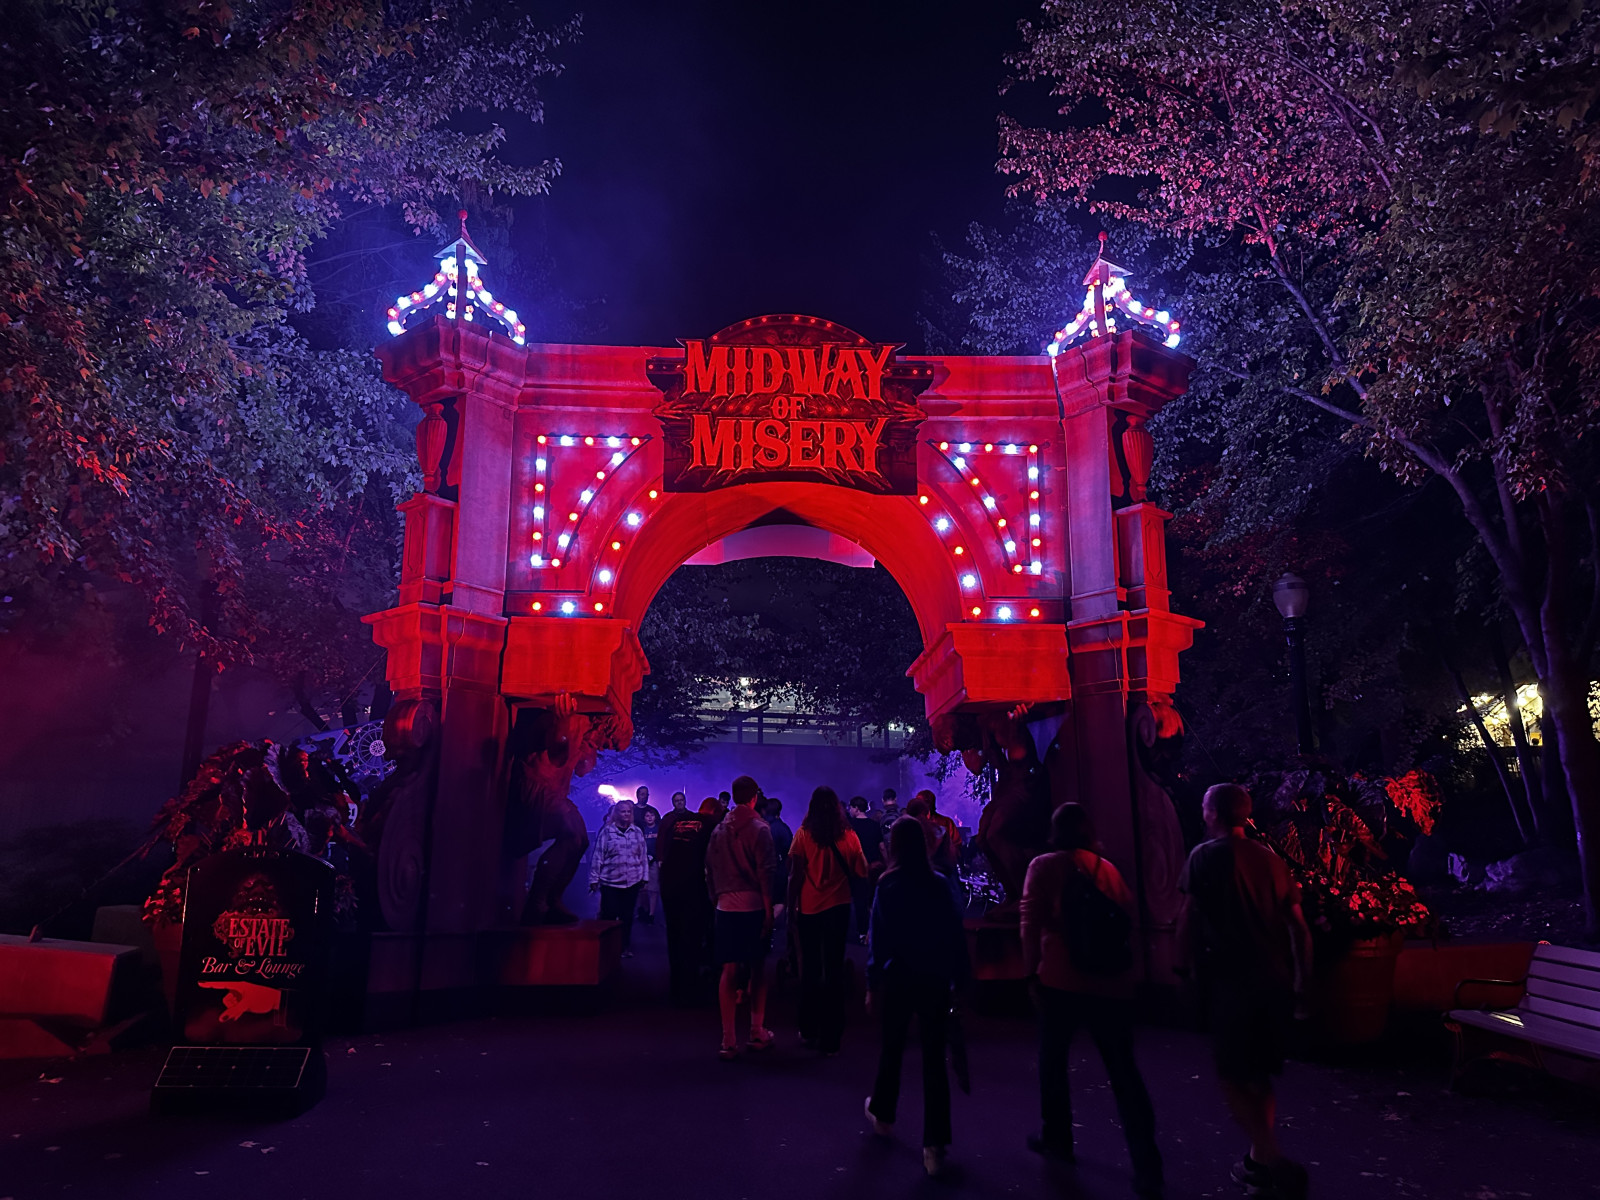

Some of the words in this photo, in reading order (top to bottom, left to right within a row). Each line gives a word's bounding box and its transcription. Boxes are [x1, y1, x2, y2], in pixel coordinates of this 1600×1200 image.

[681, 341, 894, 404] MIDWAY
[771, 396, 805, 419] OF
[686, 412, 889, 478] MISERY
[228, 918, 291, 938] ESTATE
[234, 938, 246, 949] OF
[244, 937, 288, 957] EVIL
[201, 956, 233, 974] Bar
[234, 958, 256, 975] &
[255, 957, 306, 980] Lounge
